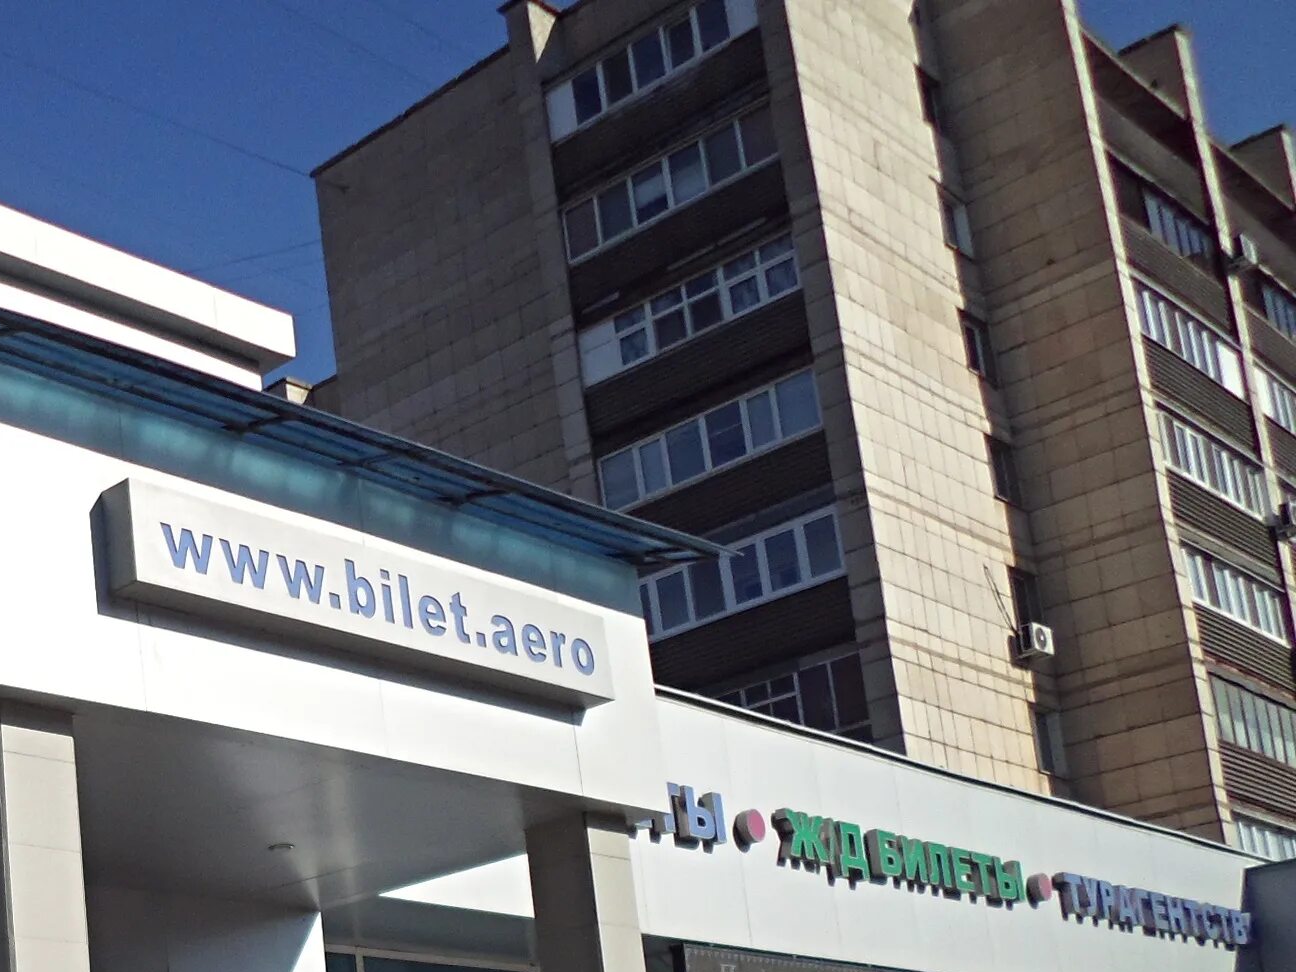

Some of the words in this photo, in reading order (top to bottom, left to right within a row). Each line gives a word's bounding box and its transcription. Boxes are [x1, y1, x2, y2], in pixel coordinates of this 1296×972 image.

[160, 522, 596, 676] www.bilet.aero
[874, 829, 1025, 901] БИЛЕТЫ
[1058, 872, 1251, 945] ТУРАГЕНТСТВ
